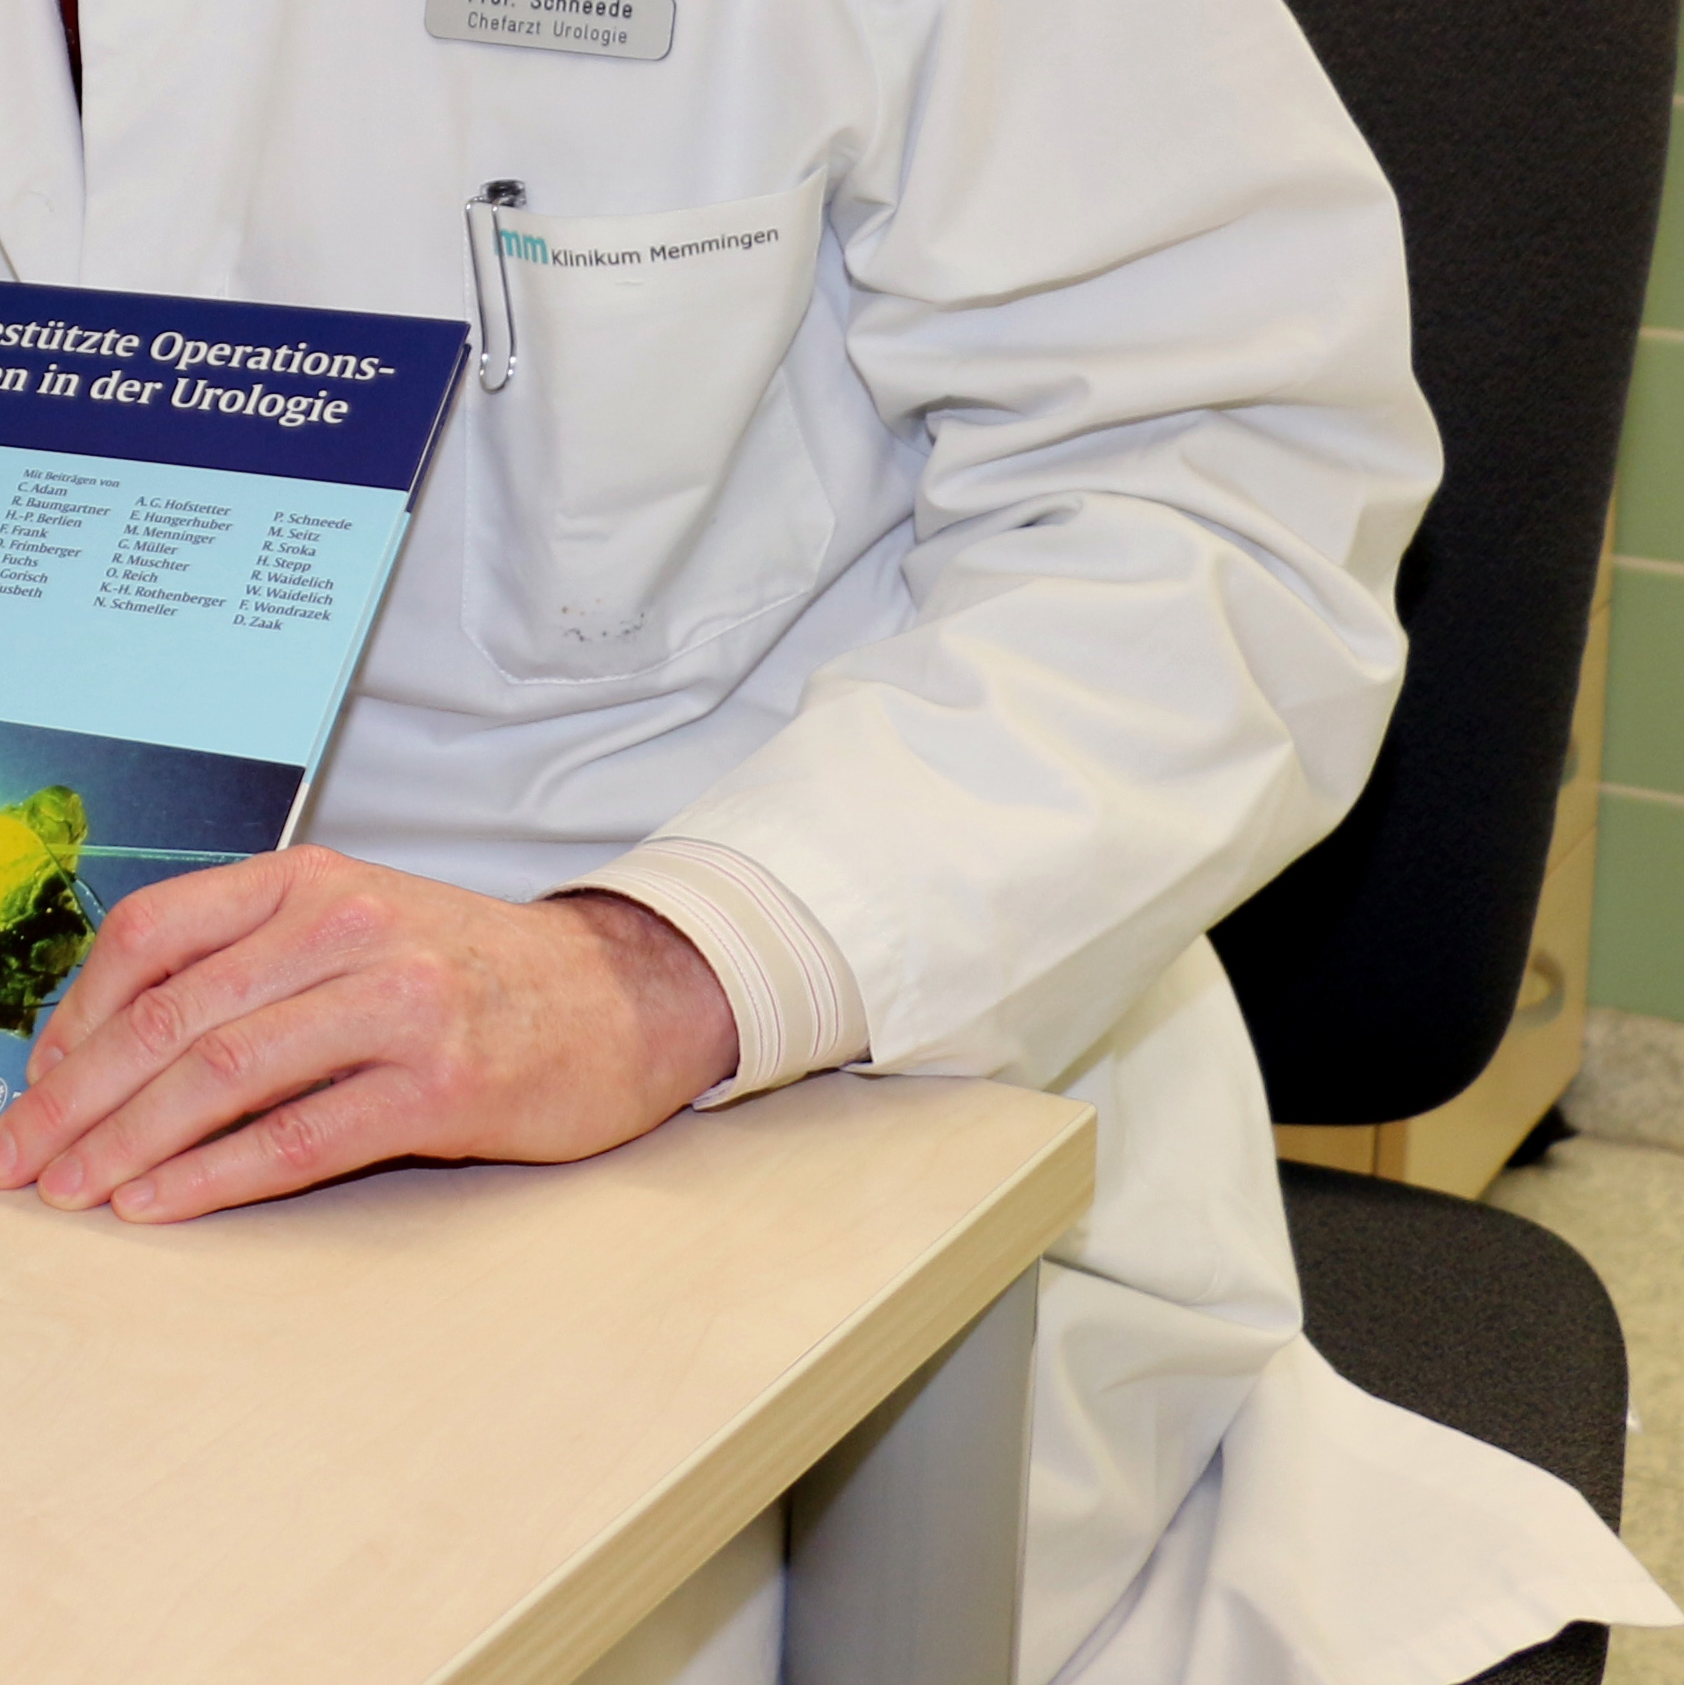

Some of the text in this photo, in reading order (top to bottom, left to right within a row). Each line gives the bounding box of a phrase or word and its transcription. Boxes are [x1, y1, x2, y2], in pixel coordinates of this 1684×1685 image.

[468, 11, 627, 47] Chefarzt Urologie
[552, 248, 641, 268] Klinikum
[650, 227, 779, 262] Memmingen
[150, 330, 396, 381] Operations-
[36, 363, 80, 397] in
[89, 369, 163, 404] der
[170, 377, 349, 427] Urologie
[23, 469, 120, 488] Mit Beiträgen von
[17, 481, 68, 497] C. Adam
[11, 496, 111, 516] R. Baumgartner
[135, 496, 232, 516] A. G. Hofstetter
[5, 509, 83, 528] H.-P. Berlien
[129, 510, 233, 532] E. Hungerhuber
[273, 511, 352, 531] P. Schneede
[0, 523, 49, 538] F. Frank
[123, 524, 216, 545] M. Menninger
[267, 526, 321, 542] M. Seitz
[9, 539, 82, 558] Frimberger
[117, 538, 179, 556] G. Müller
[262, 540, 317, 557] R. Sroka
[1, 553, 39, 567] Fuchs
[111, 553, 190, 572] R. Muschter
[256, 555, 312, 573] H. Stepp
[0, 568, 48, 584] Gorisch
[105, 567, 158, 583] O. Reich
[250, 569, 334, 590] R. Waidelich
[99, 581, 227, 608] K.-H. Rothenberger
[245, 584, 333, 605] W. Waidelich
[93, 596, 178, 617] N. Schmeller
[239, 599, 332, 621] F. Wondrazek
[233, 614, 283, 631] D. Zaak
